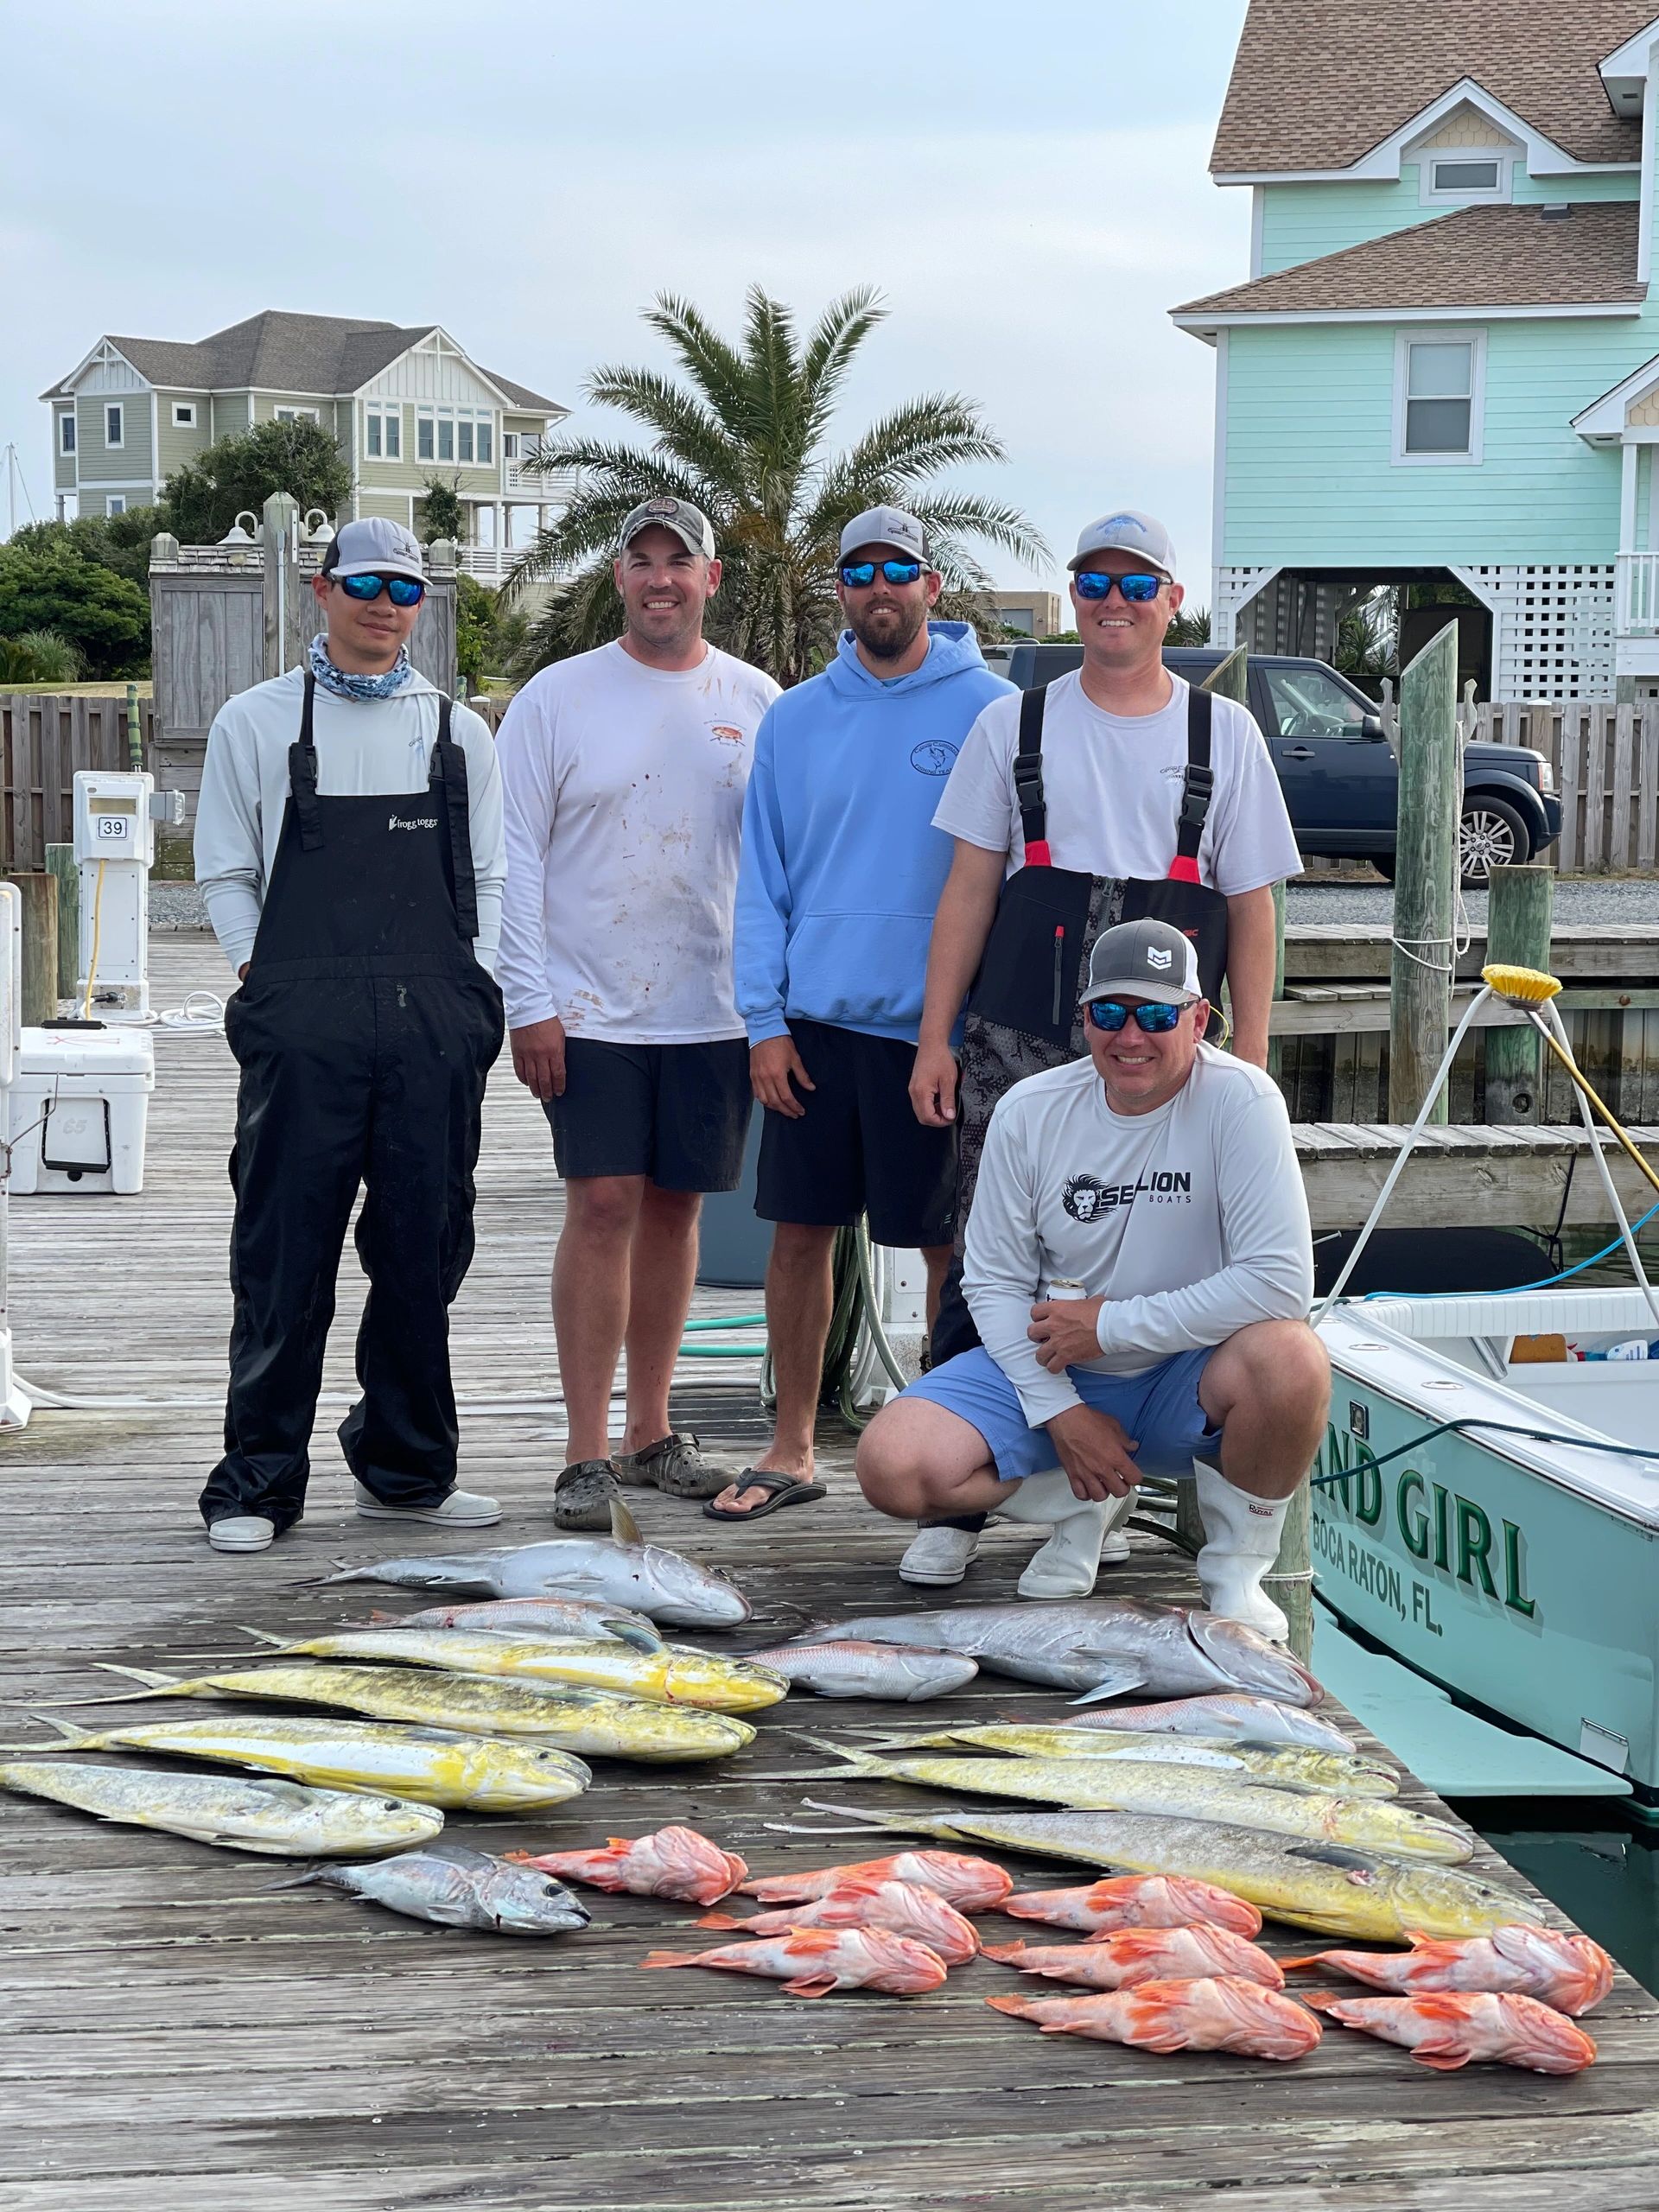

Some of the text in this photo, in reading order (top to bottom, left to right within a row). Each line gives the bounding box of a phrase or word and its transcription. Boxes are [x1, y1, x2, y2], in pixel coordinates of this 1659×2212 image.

[104, 821, 123, 835] 39
[63, 1118, 87, 1134] 65
[1149, 1195, 1192, 1204] BOATS
[1396, 1469, 1535, 1619] GIRL
[1313, 1511, 1443, 1637] BOCA RATON, FL.
